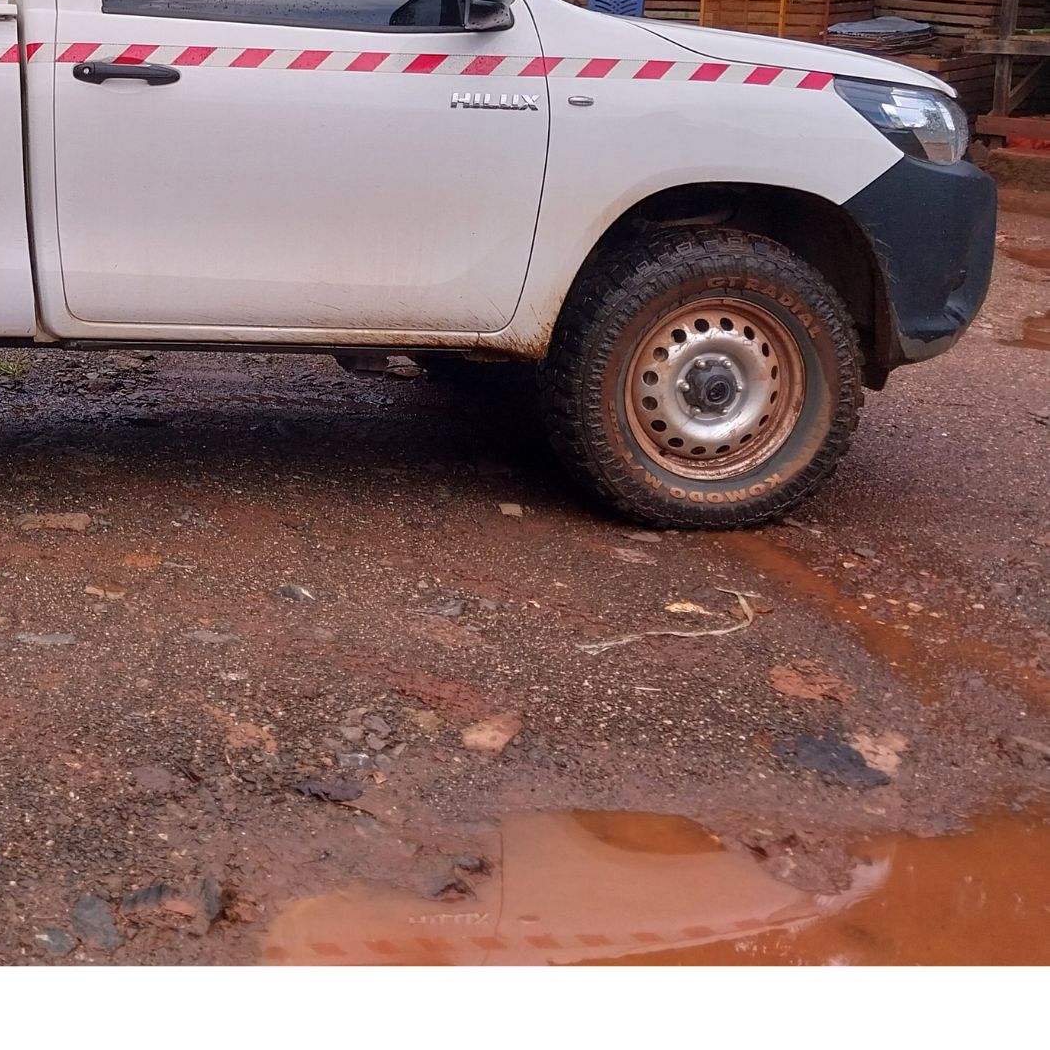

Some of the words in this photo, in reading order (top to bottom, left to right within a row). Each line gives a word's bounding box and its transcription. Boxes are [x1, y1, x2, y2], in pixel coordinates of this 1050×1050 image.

[450, 92, 540, 111] HILUX
[746, 277, 819, 339] RADIAL
[668, 473, 785, 504] KOMODO
